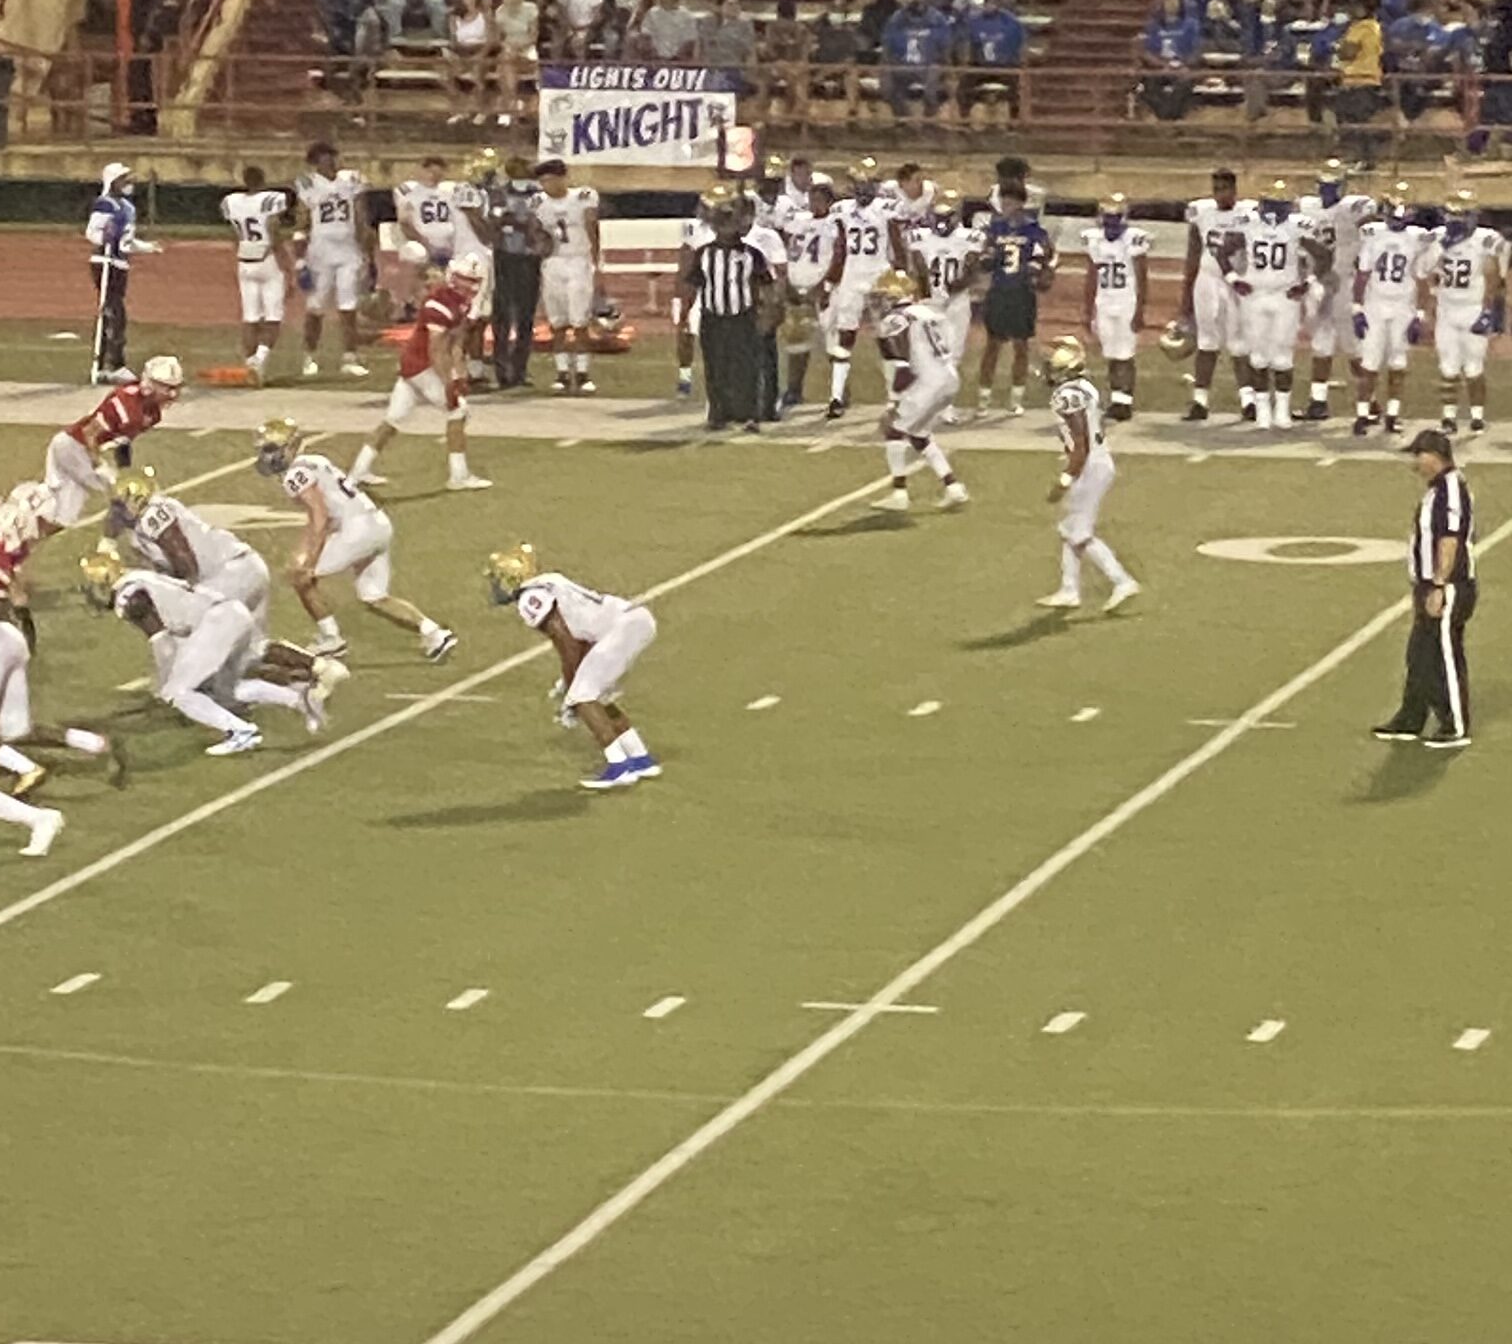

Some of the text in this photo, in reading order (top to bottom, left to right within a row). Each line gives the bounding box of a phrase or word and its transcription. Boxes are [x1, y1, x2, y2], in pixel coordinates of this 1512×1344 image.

[569, 66, 709, 90] LIGHTS OUT!
[572, 98, 703, 155] KNIGHT
[319, 199, 350, 223] 23
[420, 201, 449, 224] 60
[847, 226, 879, 255] 33
[1253, 240, 1287, 270] 50
[1000, 244, 1020, 274] 3
[1375, 251, 1407, 283] 48
[147, 507, 171, 531] 90
